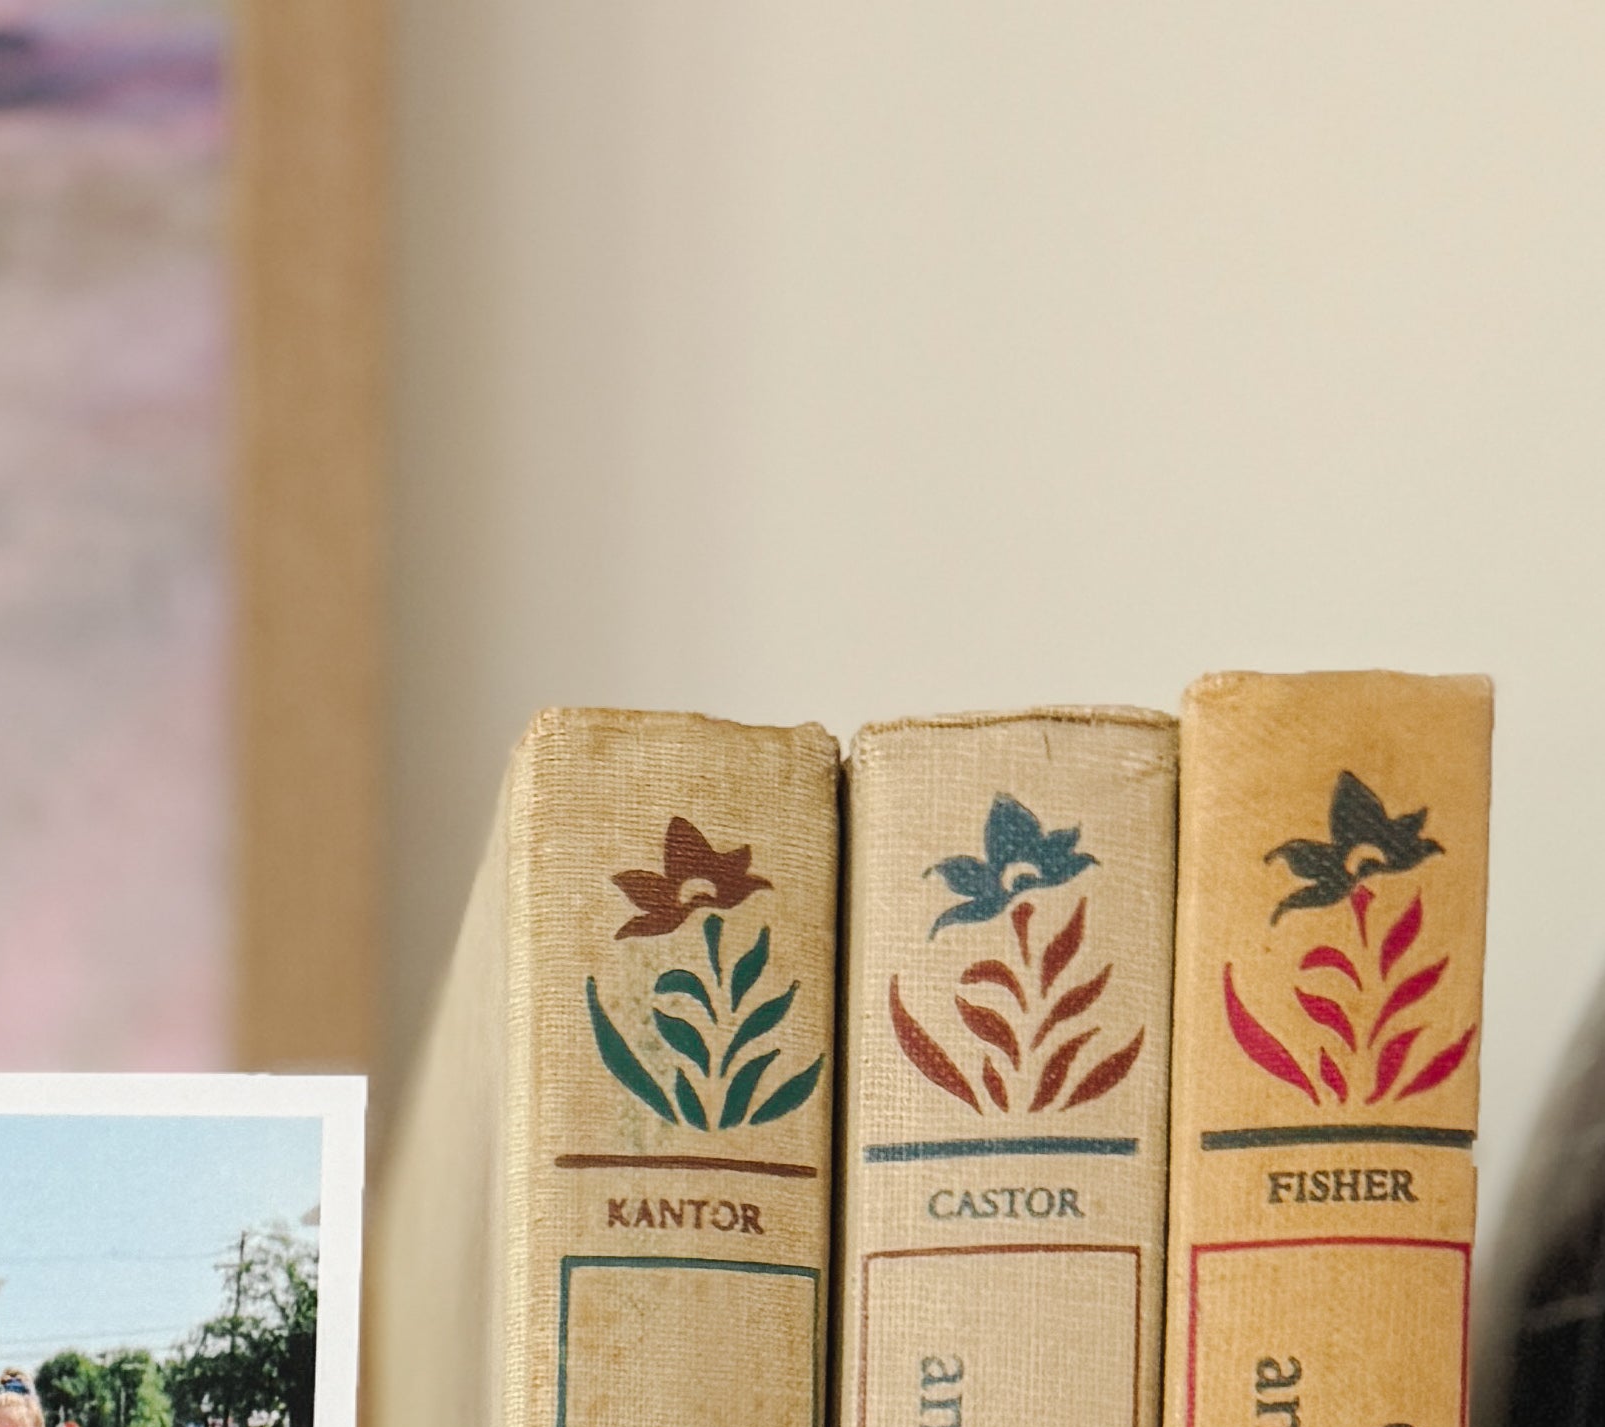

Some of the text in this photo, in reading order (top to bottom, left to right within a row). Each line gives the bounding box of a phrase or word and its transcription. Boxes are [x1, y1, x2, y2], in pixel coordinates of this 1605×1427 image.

[928, 1186, 1085, 1219] CASTOR
[1269, 1168, 1419, 1203] FISHER
[608, 1199, 765, 1235] KANTOR
